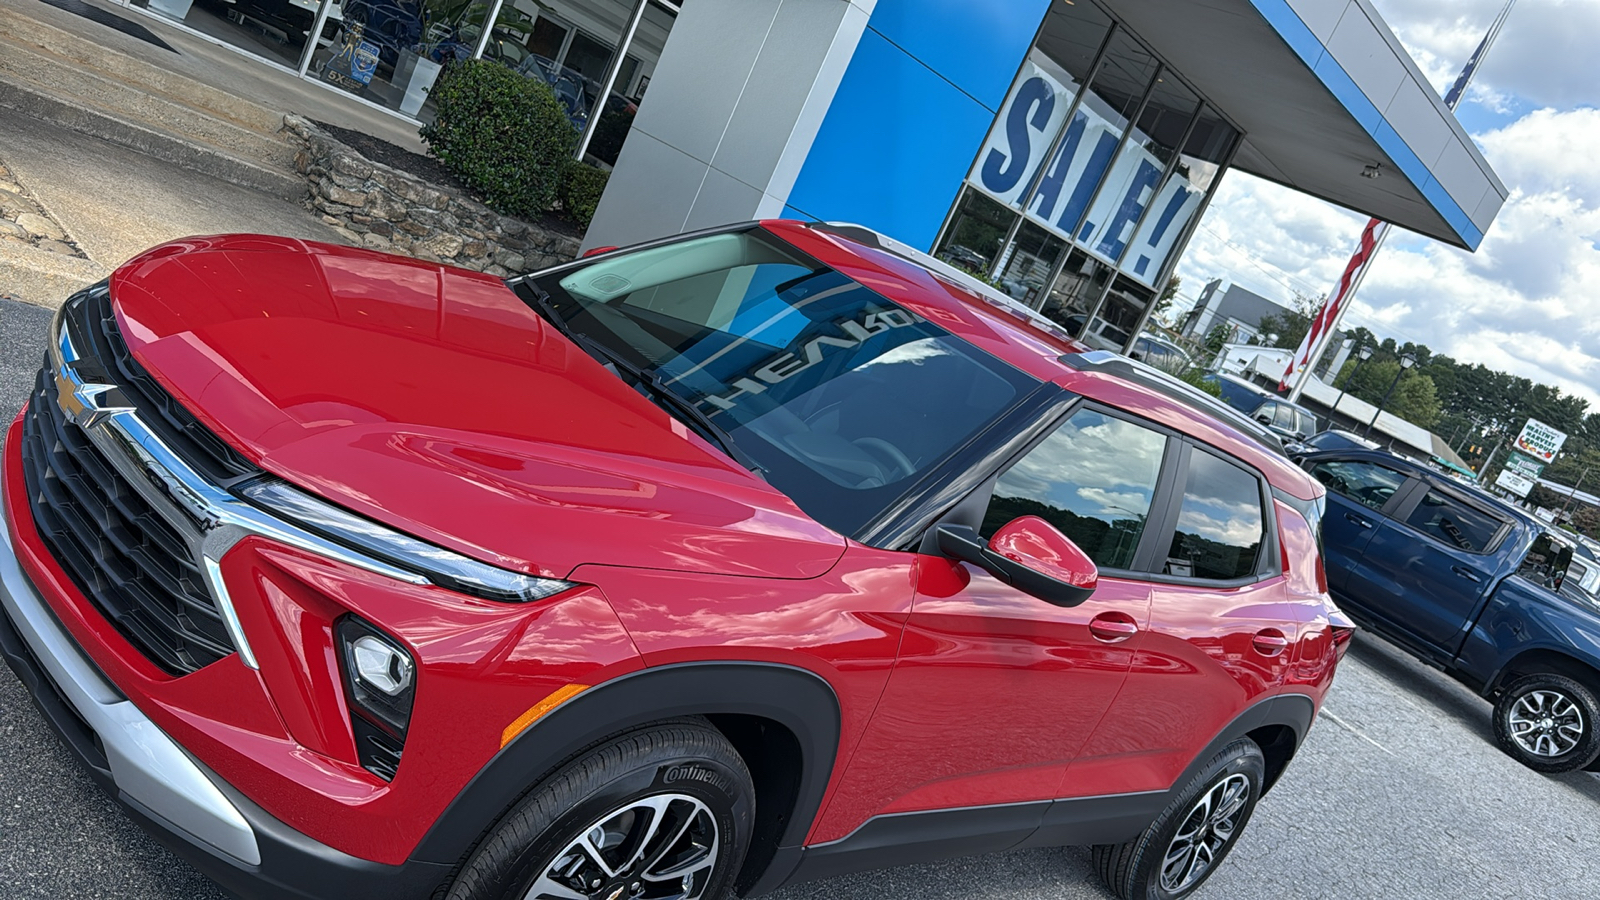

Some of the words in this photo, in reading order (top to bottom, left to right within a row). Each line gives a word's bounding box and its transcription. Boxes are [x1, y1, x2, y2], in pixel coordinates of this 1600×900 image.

[328, 70, 345, 84] 5X
[981, 77, 1192, 277] SALE!
[1525, 431, 1557, 448] HARVEST
[1526, 424, 1555, 441] HEALTHY
[1524, 437, 1556, 455] PRODUCE
[663, 764, 731, 793] Continental
